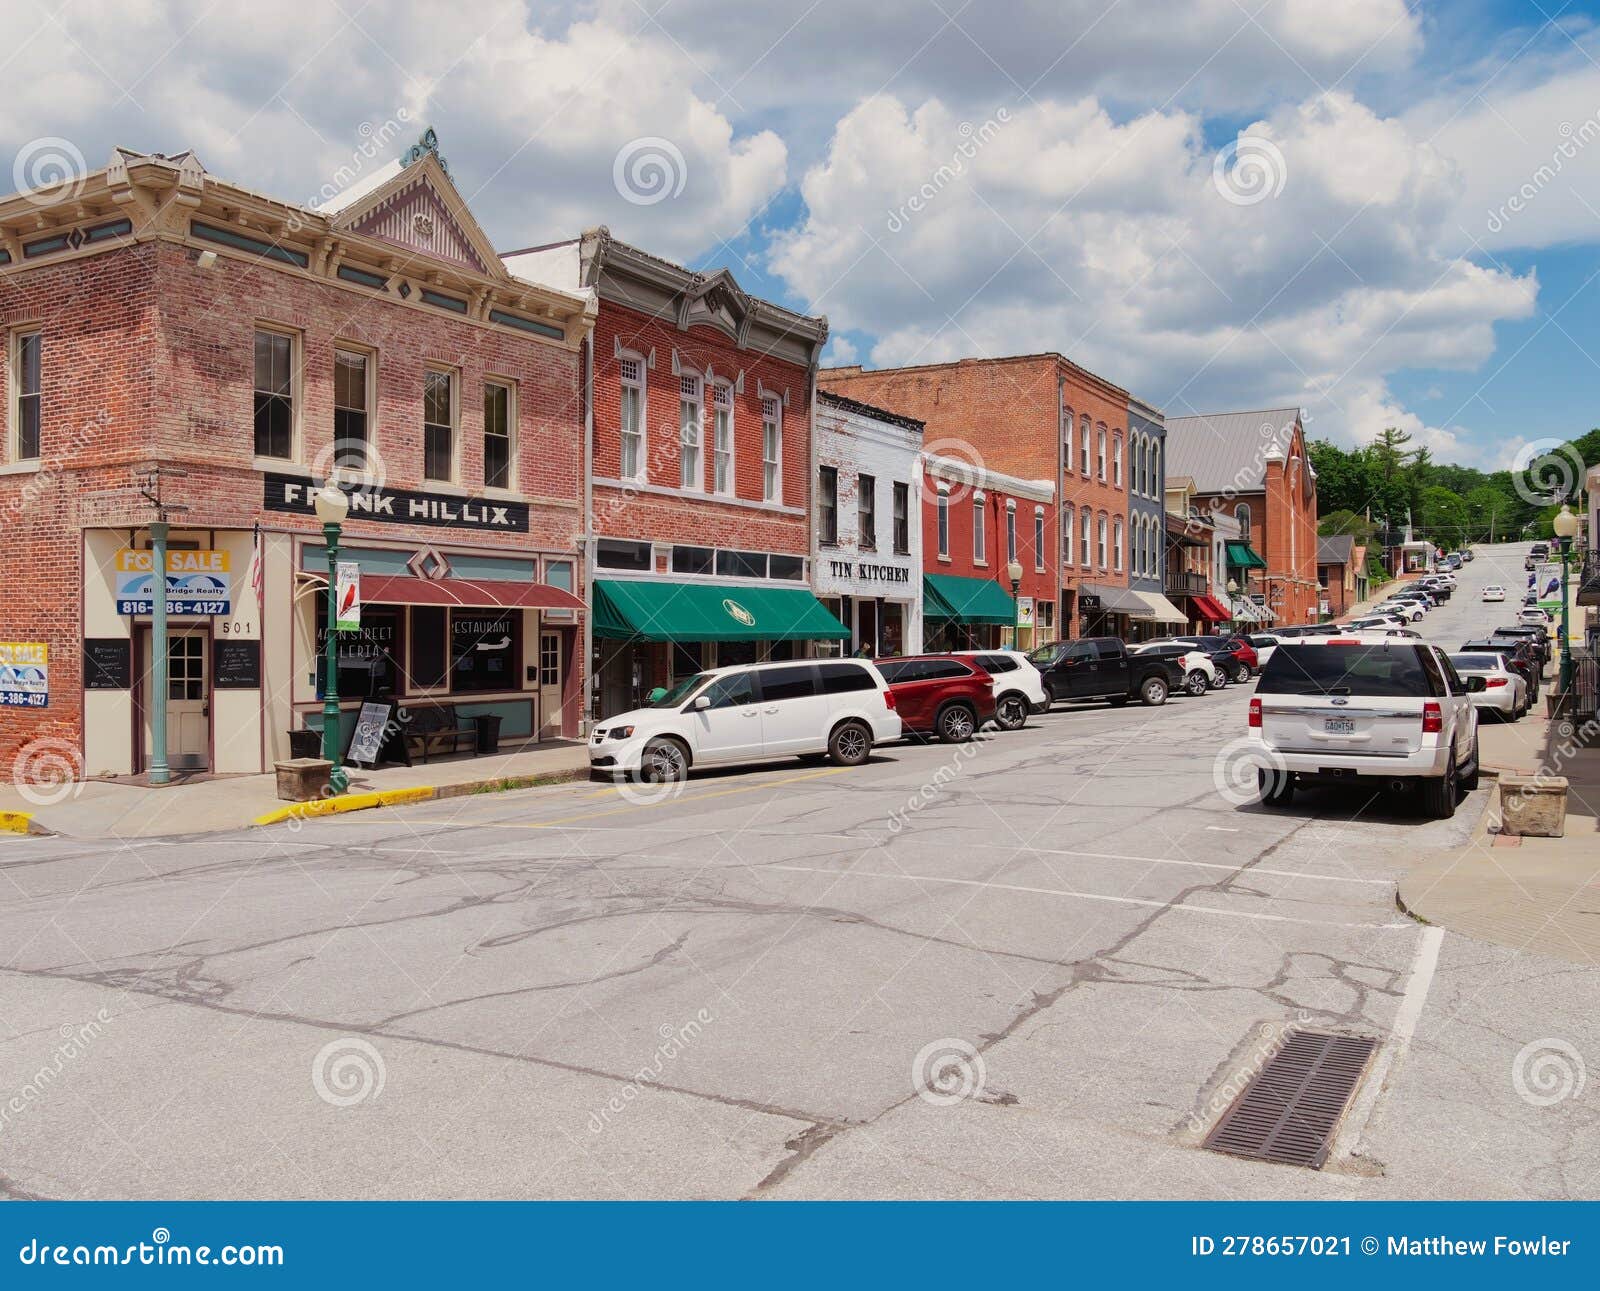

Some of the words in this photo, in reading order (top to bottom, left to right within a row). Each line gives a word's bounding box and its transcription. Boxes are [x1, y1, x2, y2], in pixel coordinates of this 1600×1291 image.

[285, 483, 396, 515] FRNK
[123, 552, 155, 570] FO
[171, 552, 224, 570] SALE
[830, 561, 853, 578] TIN
[859, 563, 909, 583] KITCHEN
[196, 587, 225, 596] Realty
[122, 601, 226, 614] 816-86-4127
[223, 622, 250, 634] 501
[350, 626, 392, 641] STREET
